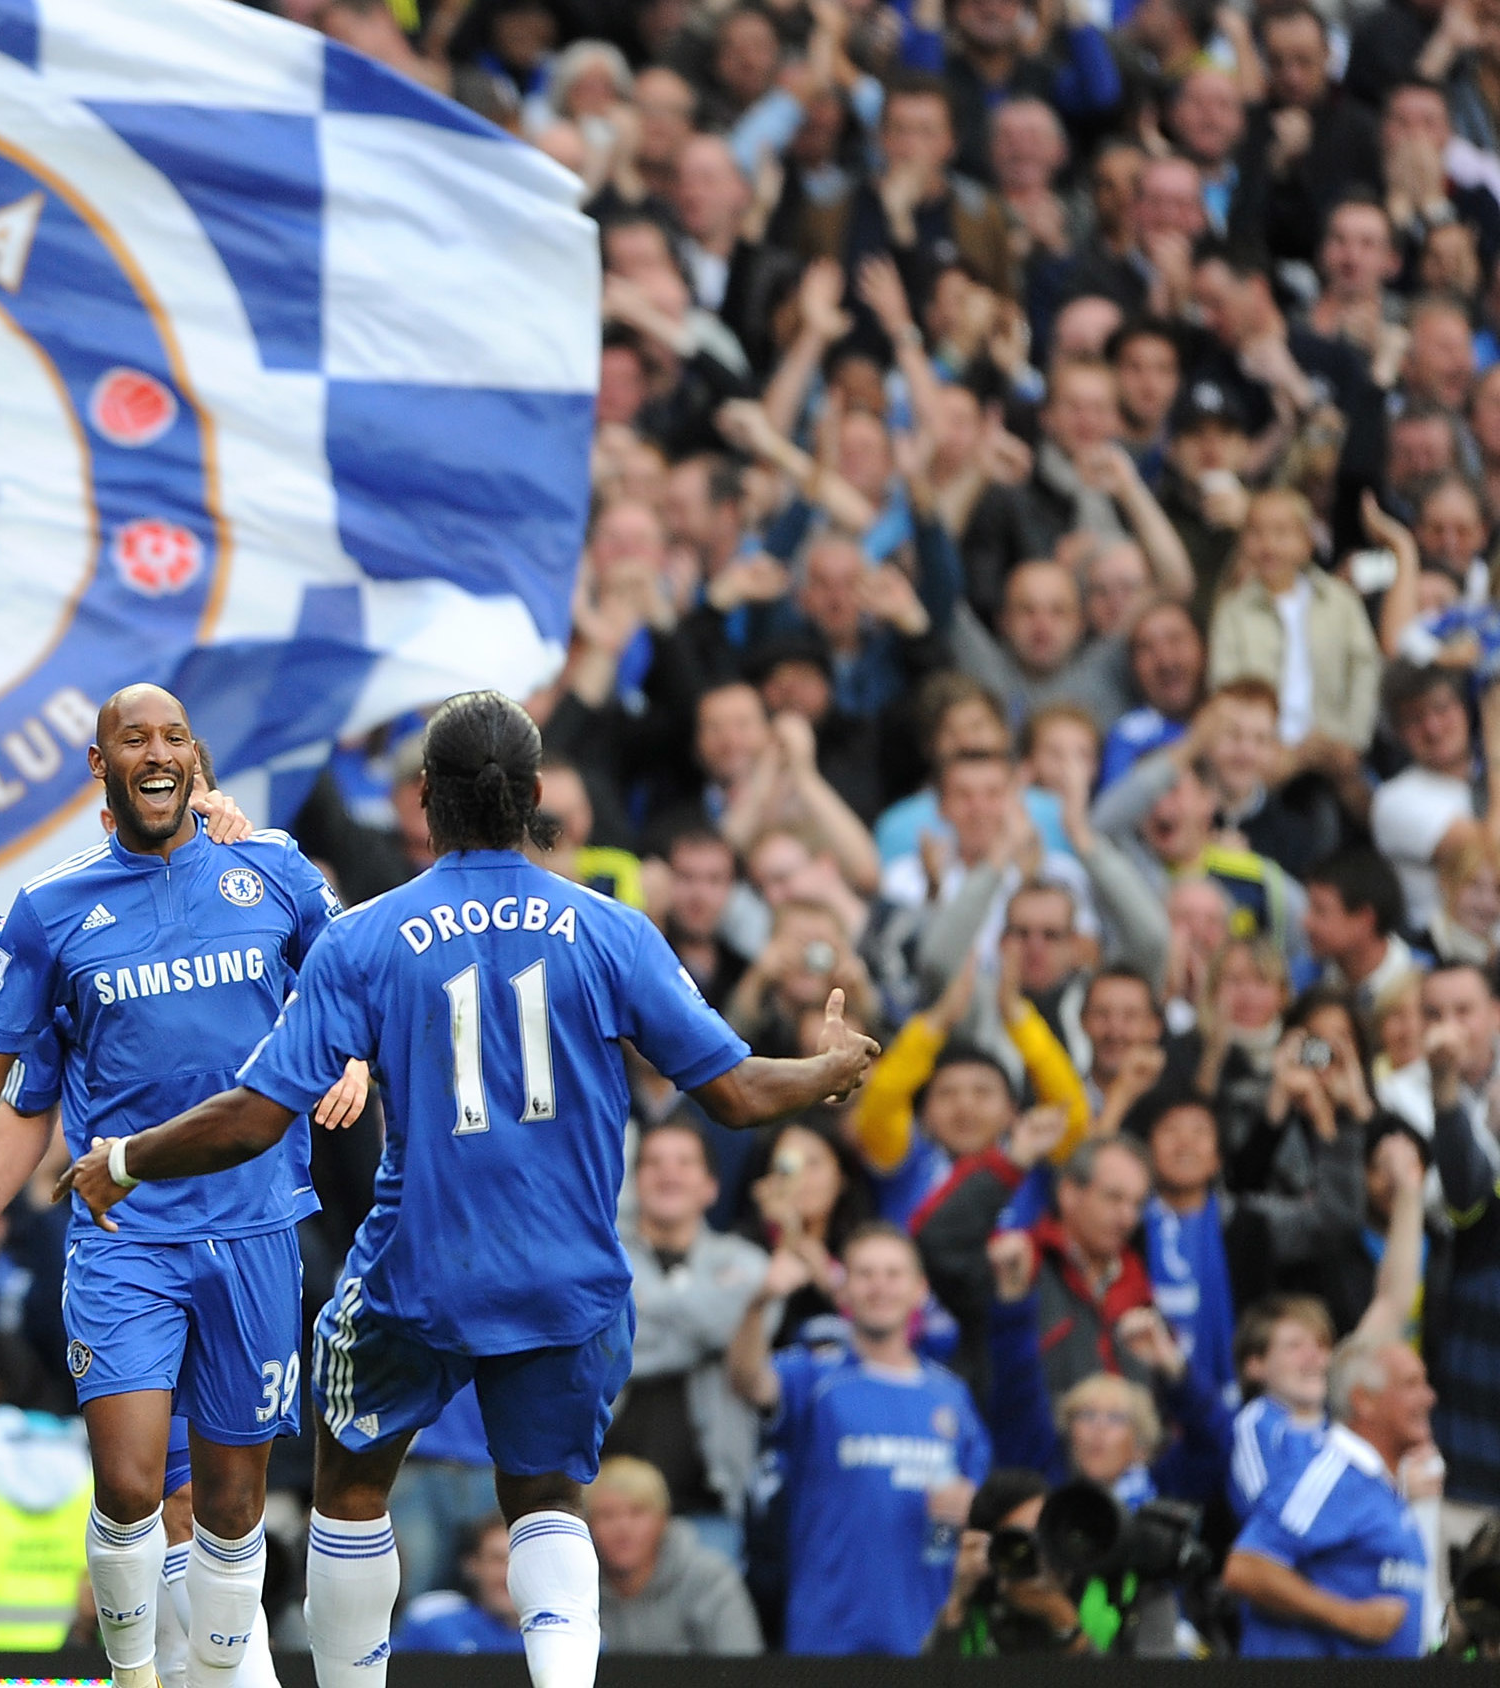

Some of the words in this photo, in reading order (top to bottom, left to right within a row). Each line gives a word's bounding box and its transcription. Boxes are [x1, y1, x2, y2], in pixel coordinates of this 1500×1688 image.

[82, 915, 117, 930] adidas
[399, 895, 577, 957] DROGBA
[93, 947, 264, 1005] SAMSUNG
[442, 958, 557, 1136] 11
[255, 1351, 300, 1423] 39
[101, 1603, 147, 1620] CFC
